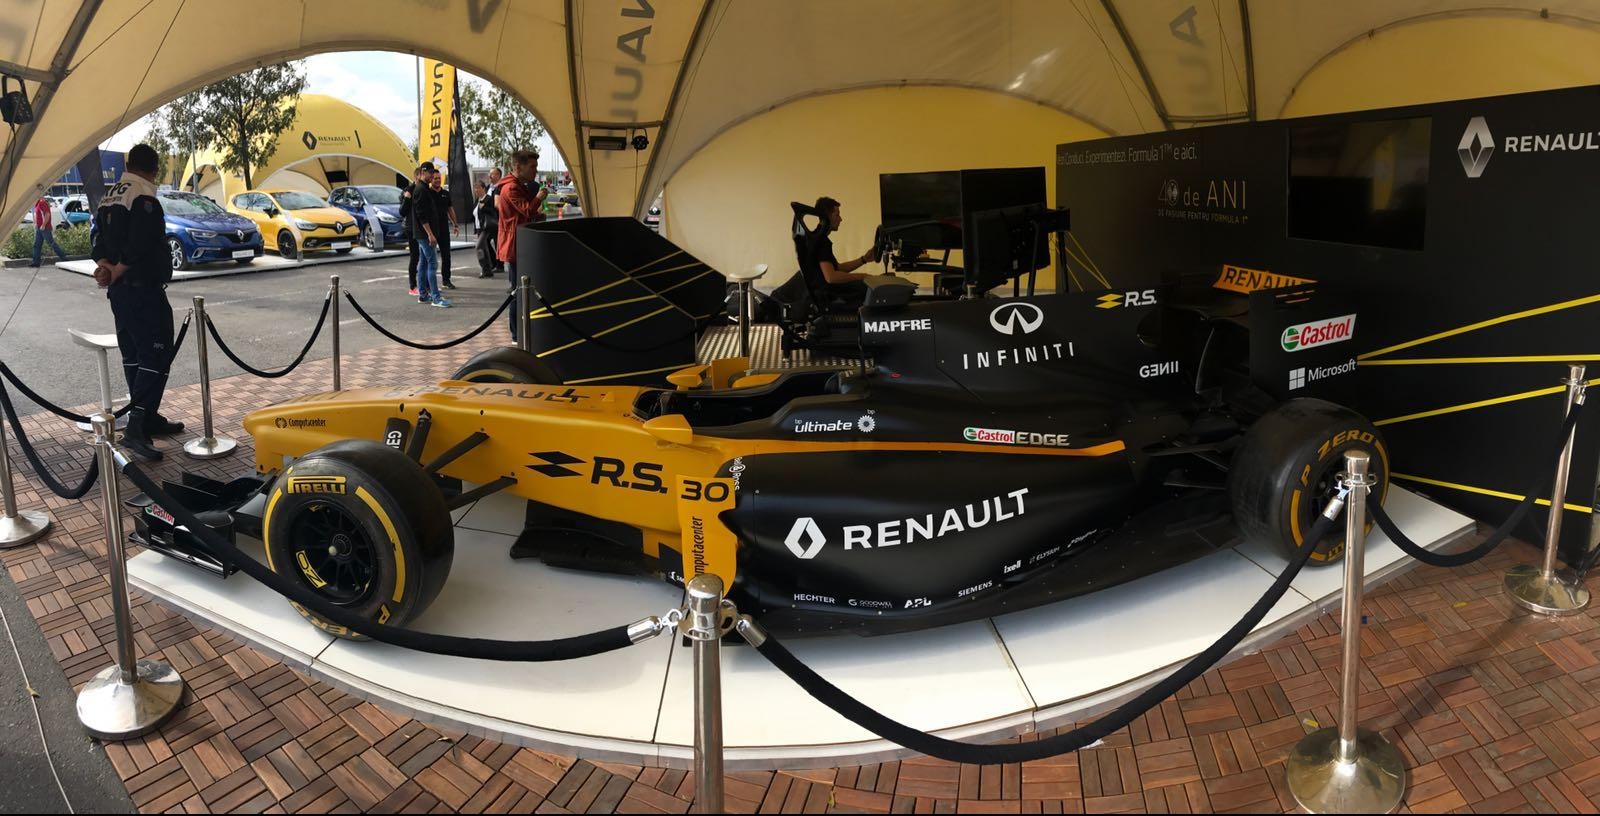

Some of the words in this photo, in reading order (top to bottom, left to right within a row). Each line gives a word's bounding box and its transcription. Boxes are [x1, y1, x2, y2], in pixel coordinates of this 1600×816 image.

[1129, 144, 1159, 163] Formula
[1174, 148, 1180, 160] e
[1184, 187, 1200, 206] de
[1207, 180, 1247, 209] ANI
[1211, 213, 1240, 224] FORMULA
[1124, 289, 1158, 308] R.S.
[864, 318, 932, 333] MAPFRE
[1300, 318, 1352, 347] Castrol
[963, 342, 1074, 370] INFINITI
[1307, 358, 1356, 382] Microsoft
[795, 420, 852, 433] ultimate
[386, 430, 402, 449] GE
[976, 430, 1014, 443] Castrol
[1016, 431, 1070, 446] EDGE
[1301, 464, 1311, 487] P
[1317, 429, 1374, 461] ZERO
[288, 475, 347, 494] PIRELLI
[591, 456, 668, 494] R.S.
[681, 480, 729, 502] 30
[843, 487, 1029, 550] RENAULT
[692, 516, 708, 577] mputacenter
[958, 580, 993, 597] SIEMENS
[793, 593, 836, 604] HECHTER
